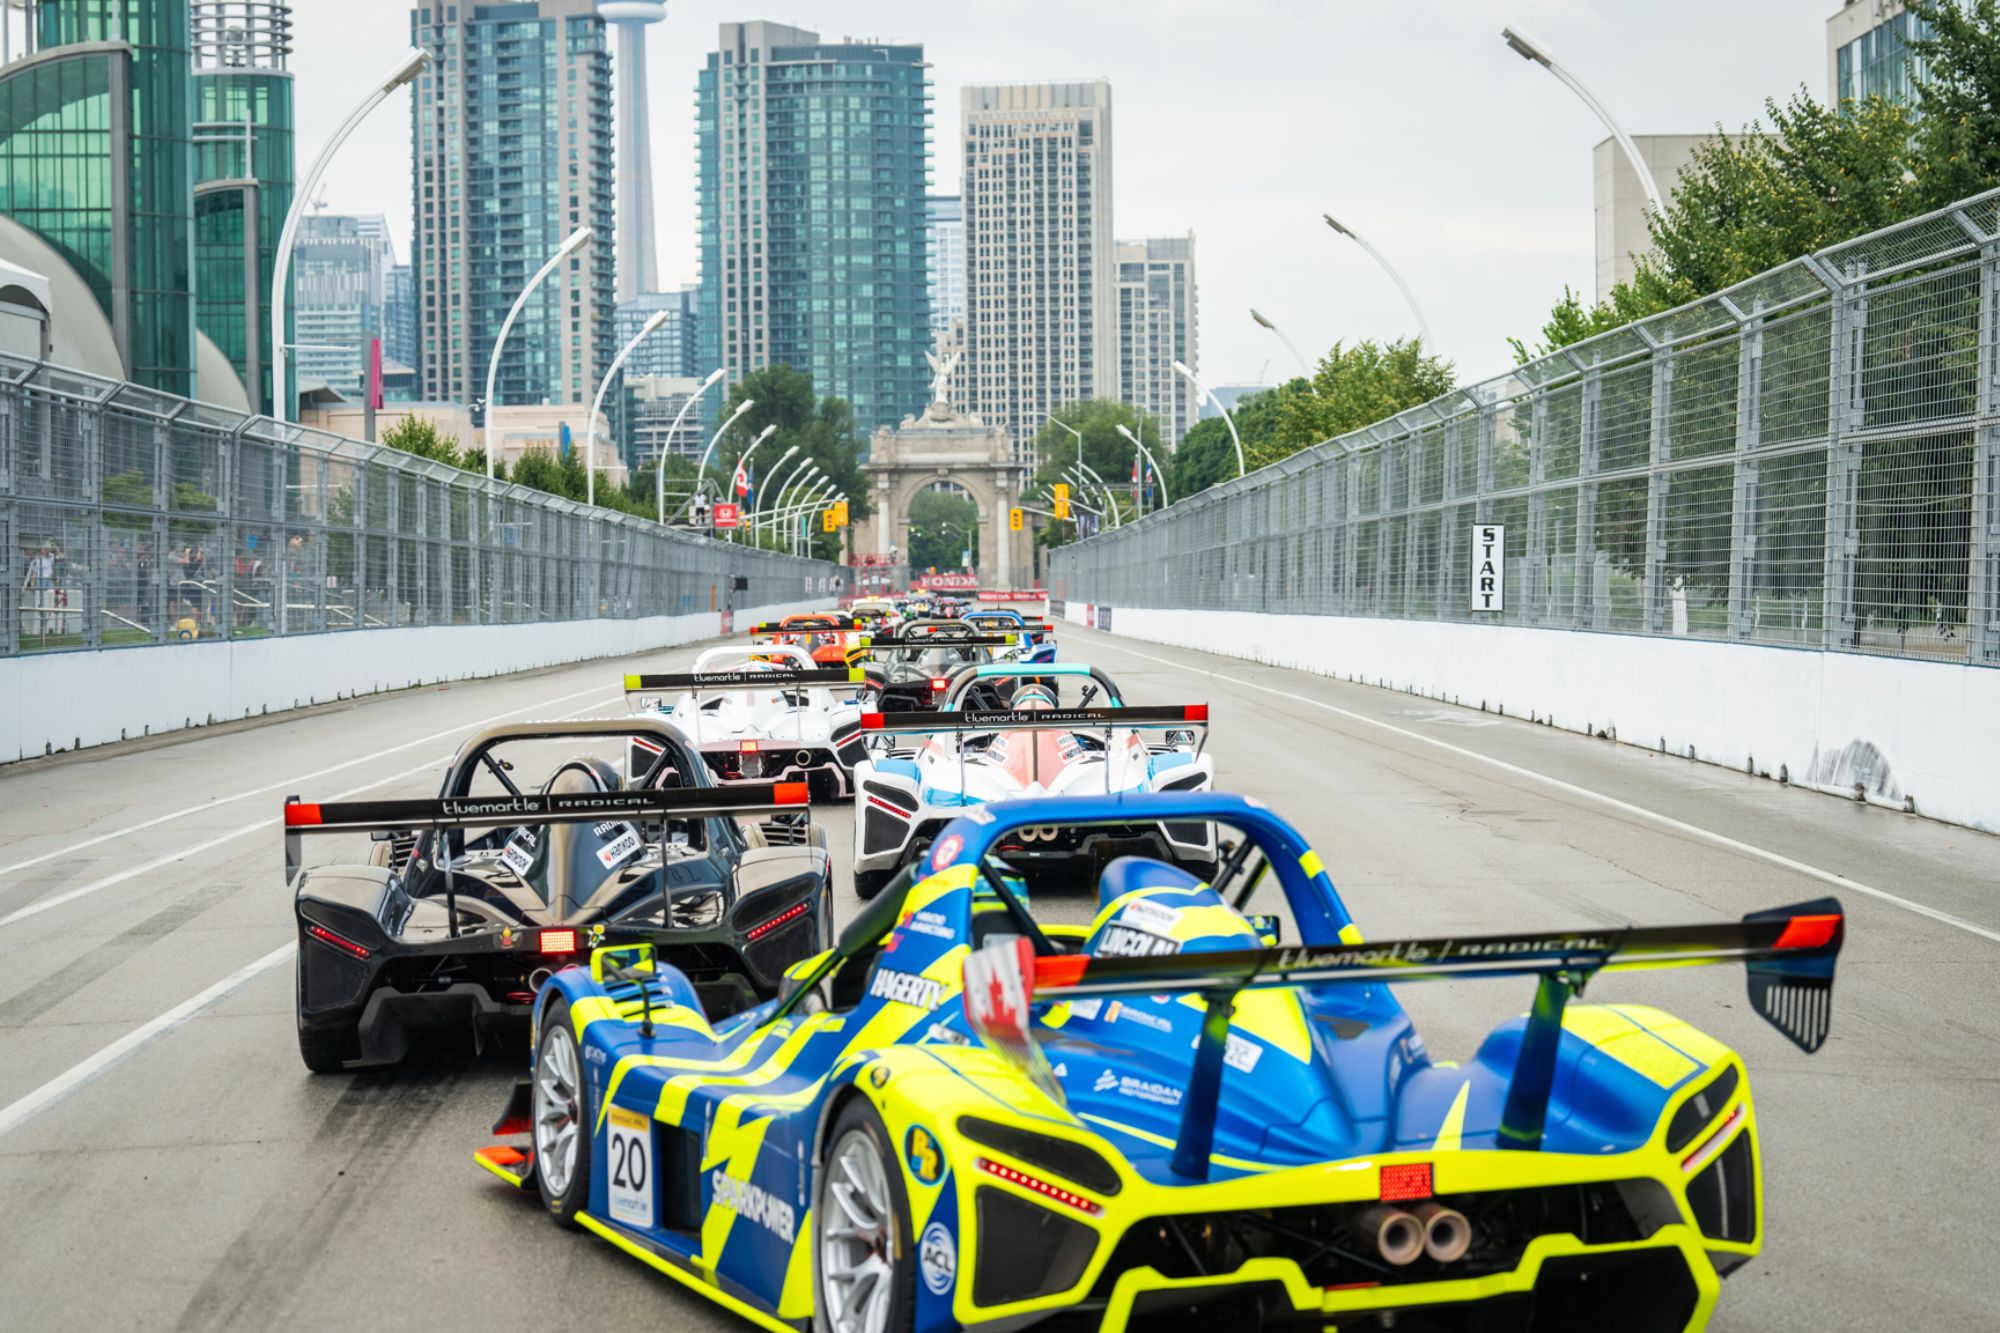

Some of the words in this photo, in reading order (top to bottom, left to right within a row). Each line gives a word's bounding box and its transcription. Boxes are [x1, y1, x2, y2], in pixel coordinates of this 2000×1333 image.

[1480, 528, 1495, 608] START
[1041, 712, 1106, 720] RADICAL
[558, 797, 655, 808] RADICAL
[1458, 936, 1606, 957] RADICAL
[870, 968, 948, 1011] HAGERTY
[612, 1132, 647, 1192] 20
[711, 1169, 795, 1245] SPARKPOWER
[924, 1246, 951, 1273] ACL
